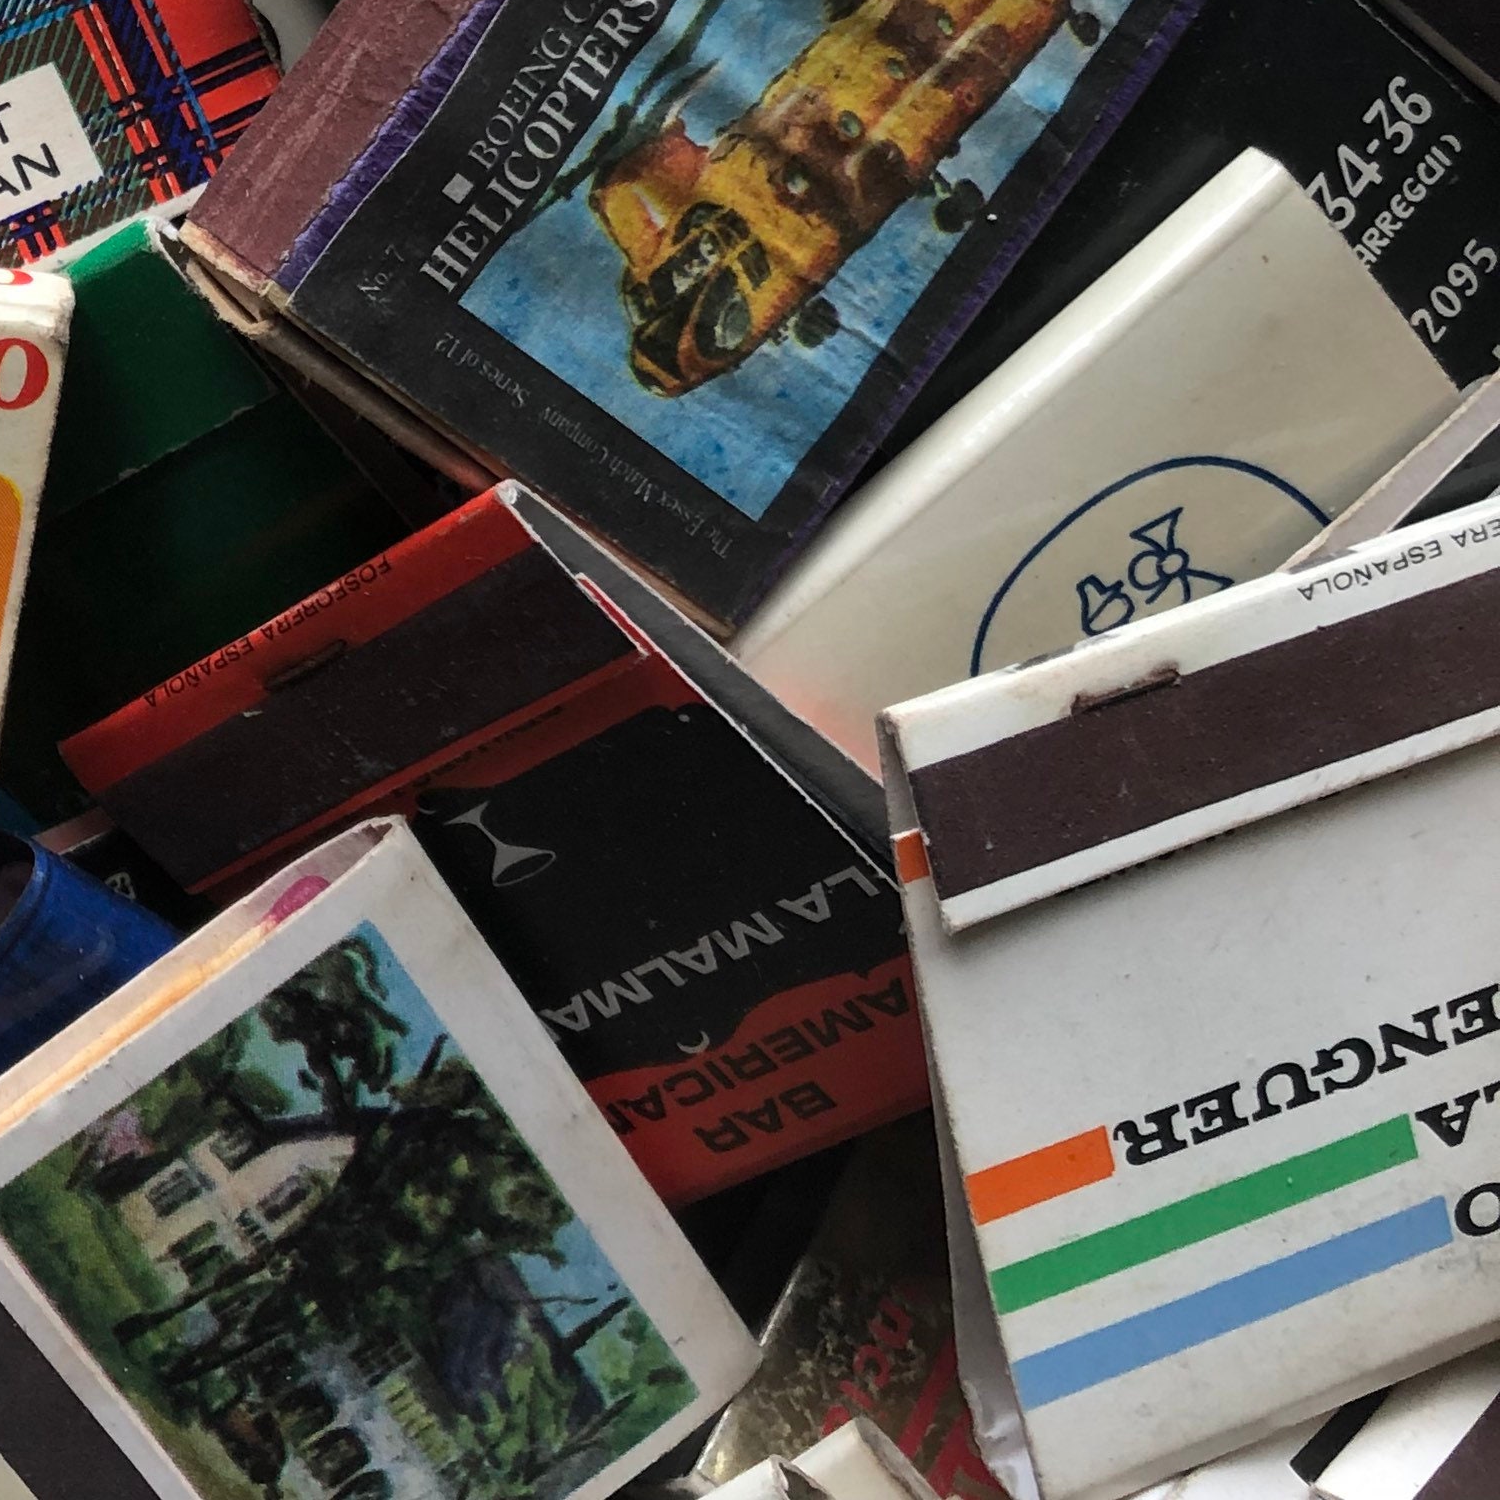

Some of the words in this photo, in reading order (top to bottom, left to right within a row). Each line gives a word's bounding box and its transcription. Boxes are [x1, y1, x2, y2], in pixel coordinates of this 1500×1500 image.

[467, 17, 576, 168] BOEING
[383, 243, 408, 265] 7
[1410, 237, 1500, 344] 2095
[432, 330, 463, 360] 12
[454, 346, 482, 375] of
[473, 360, 532, 410] Series
[535, 401, 614, 467] Company
[603, 454, 660, 503] Match
[652, 490, 707, 537] Essex
[1299, 542, 1442, 600] ESPAÑOLA
[776, 864, 880, 923] LA
[537, 912, 784, 1042] MALMA
[695, 1080, 837, 1155] BAR
[1415, 1080, 1500, 1148] A
